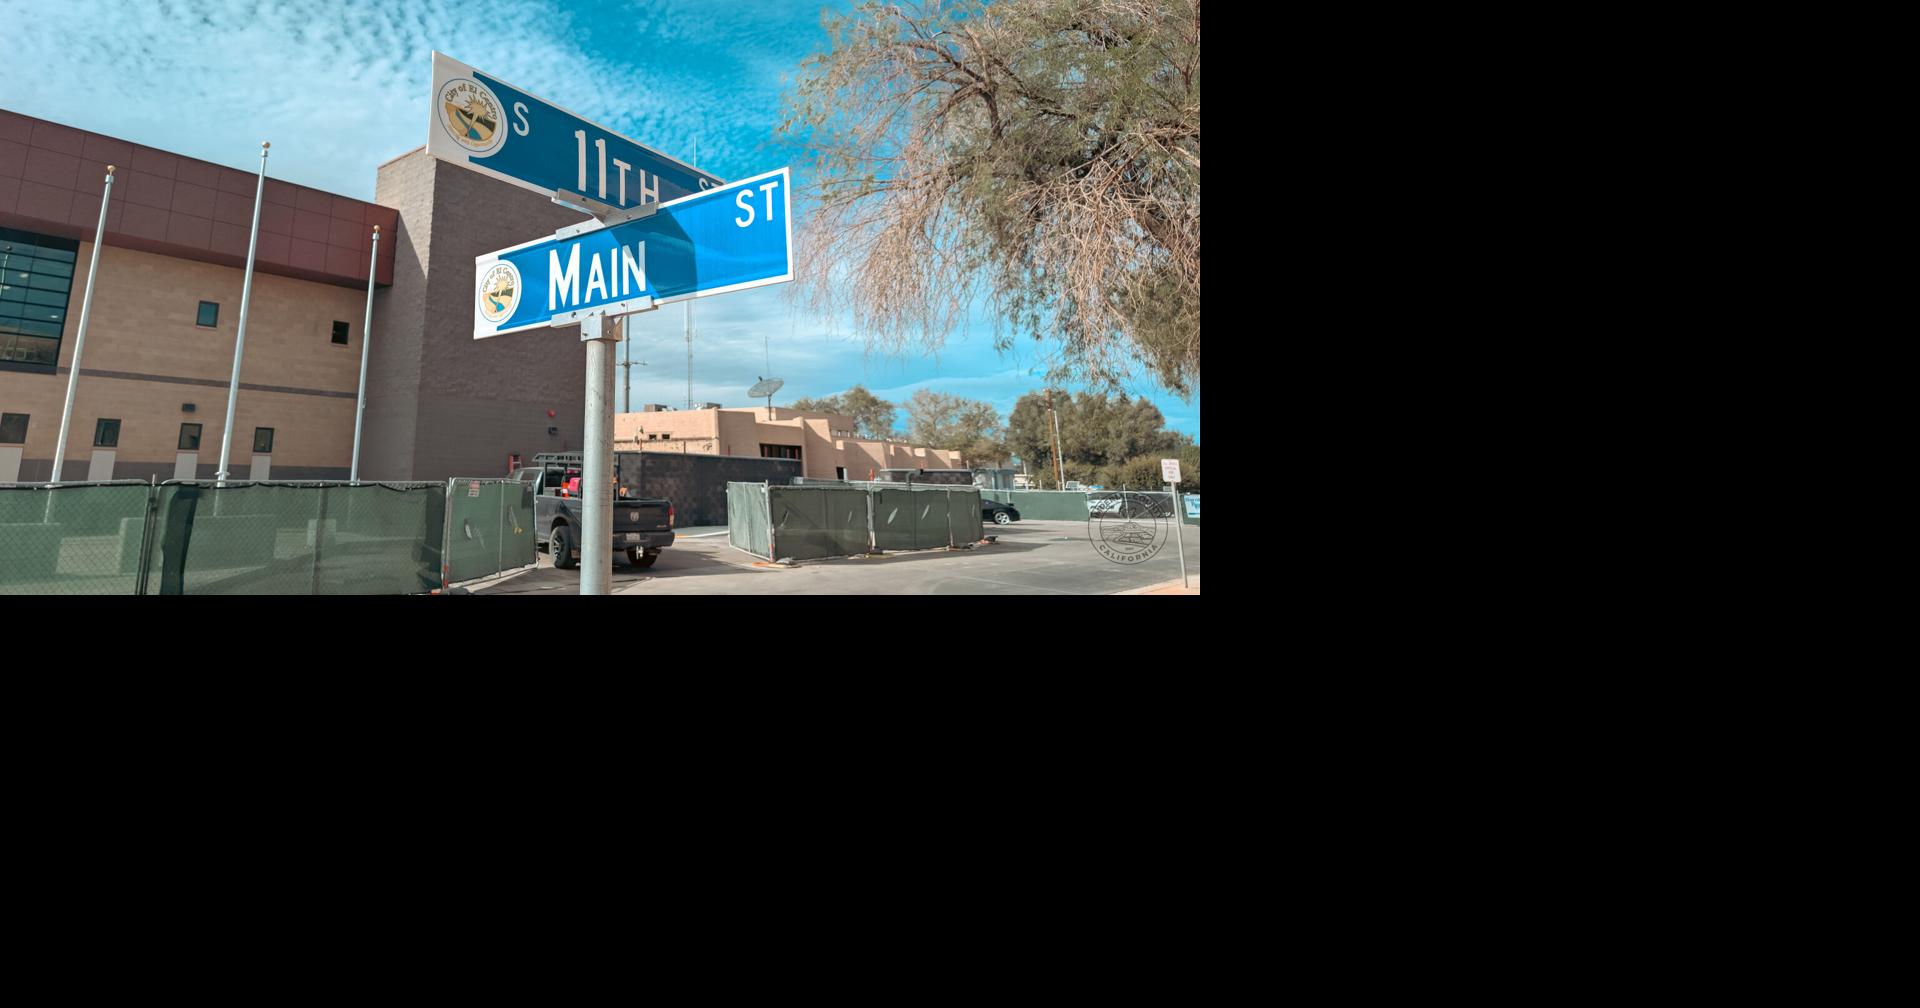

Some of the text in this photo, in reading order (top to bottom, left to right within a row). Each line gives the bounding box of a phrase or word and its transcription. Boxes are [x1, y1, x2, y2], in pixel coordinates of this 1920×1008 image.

[445, 88, 459, 102] City
[459, 83, 467, 92] of
[513, 101, 529, 137] S
[575, 129, 659, 206] 11TH
[548, 181, 779, 311] MAIN ST
